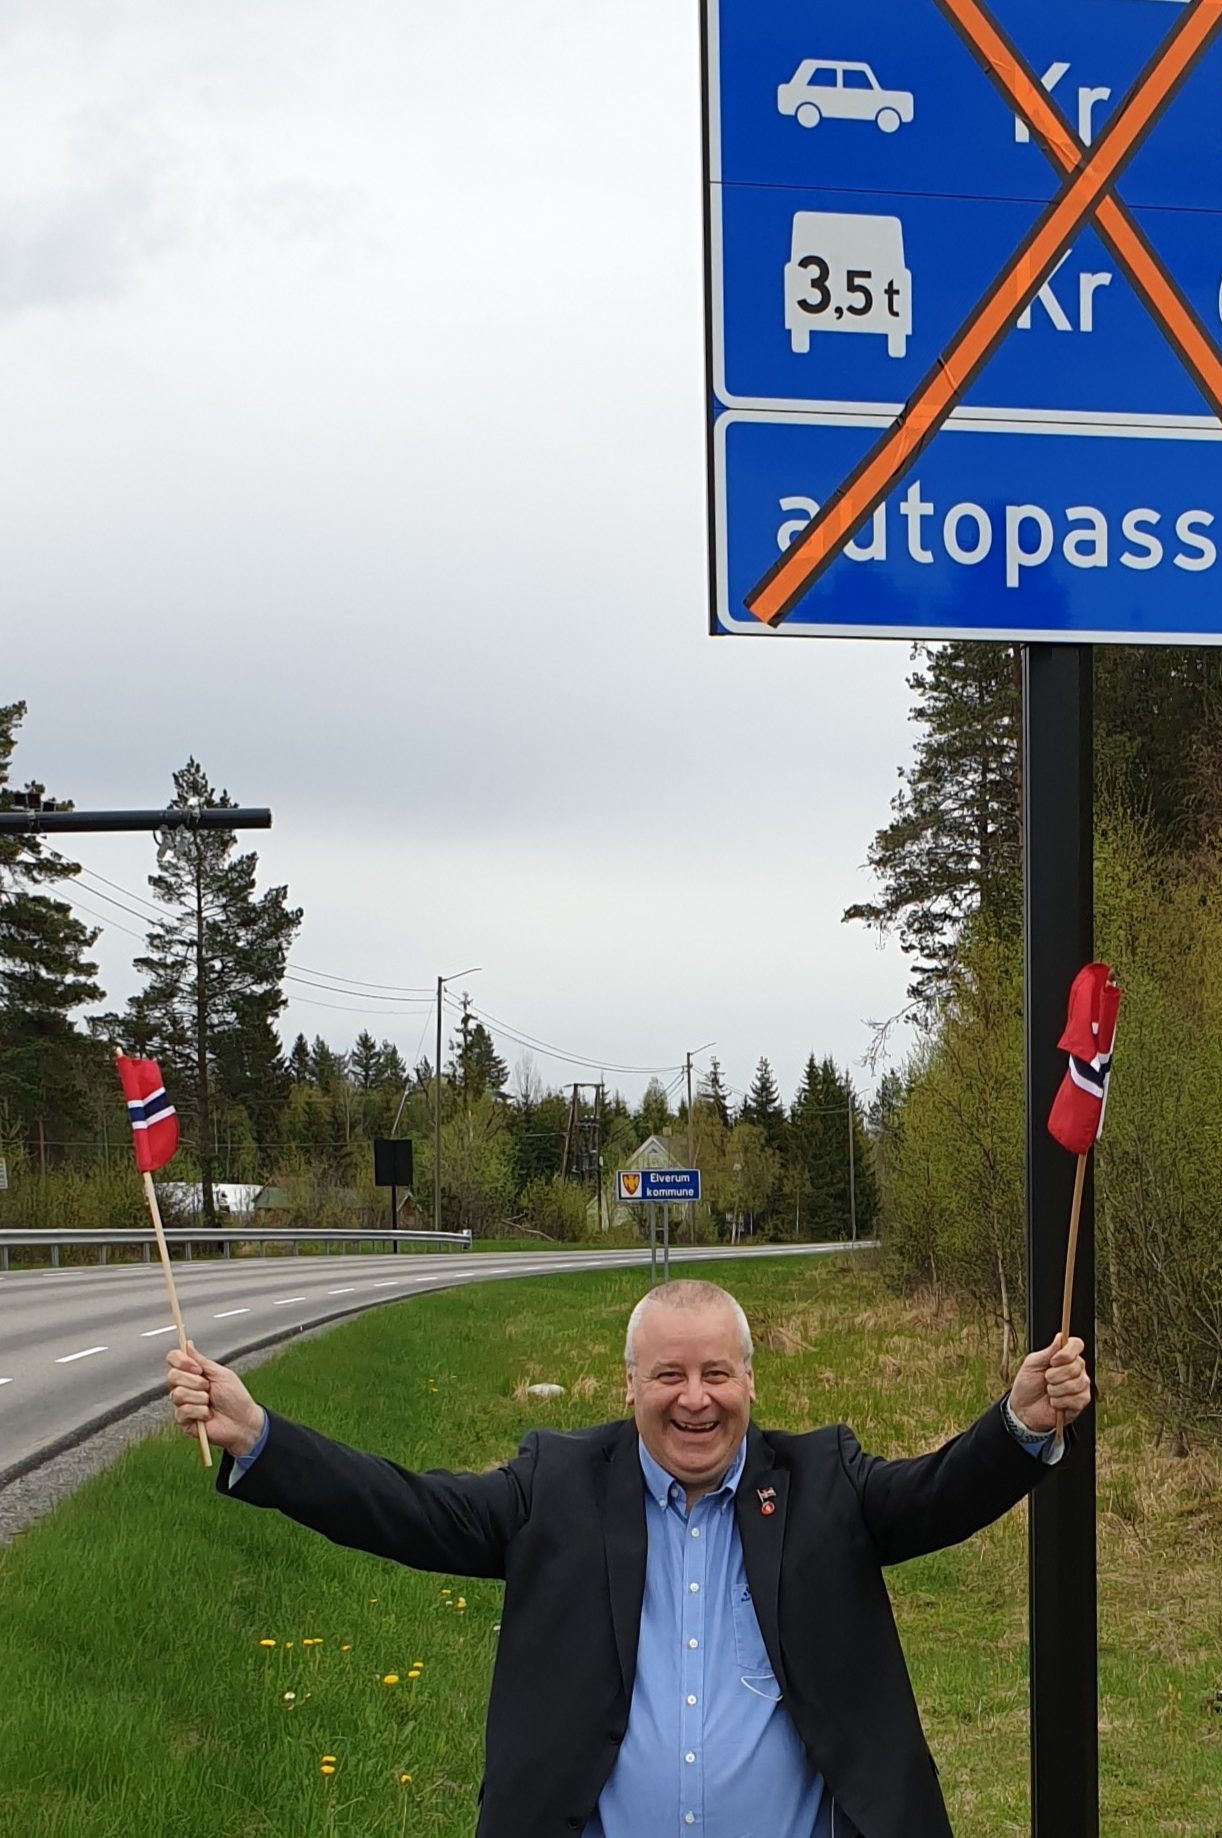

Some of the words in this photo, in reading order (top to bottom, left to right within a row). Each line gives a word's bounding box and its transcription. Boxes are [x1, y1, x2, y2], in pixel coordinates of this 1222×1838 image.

[1015, 61, 1111, 147] r
[796, 254, 873, 320] 3,5
[883, 278, 900, 318] t
[646, 1187, 694, 1198] kommune
[650, 1173, 690, 1183] Elverum
